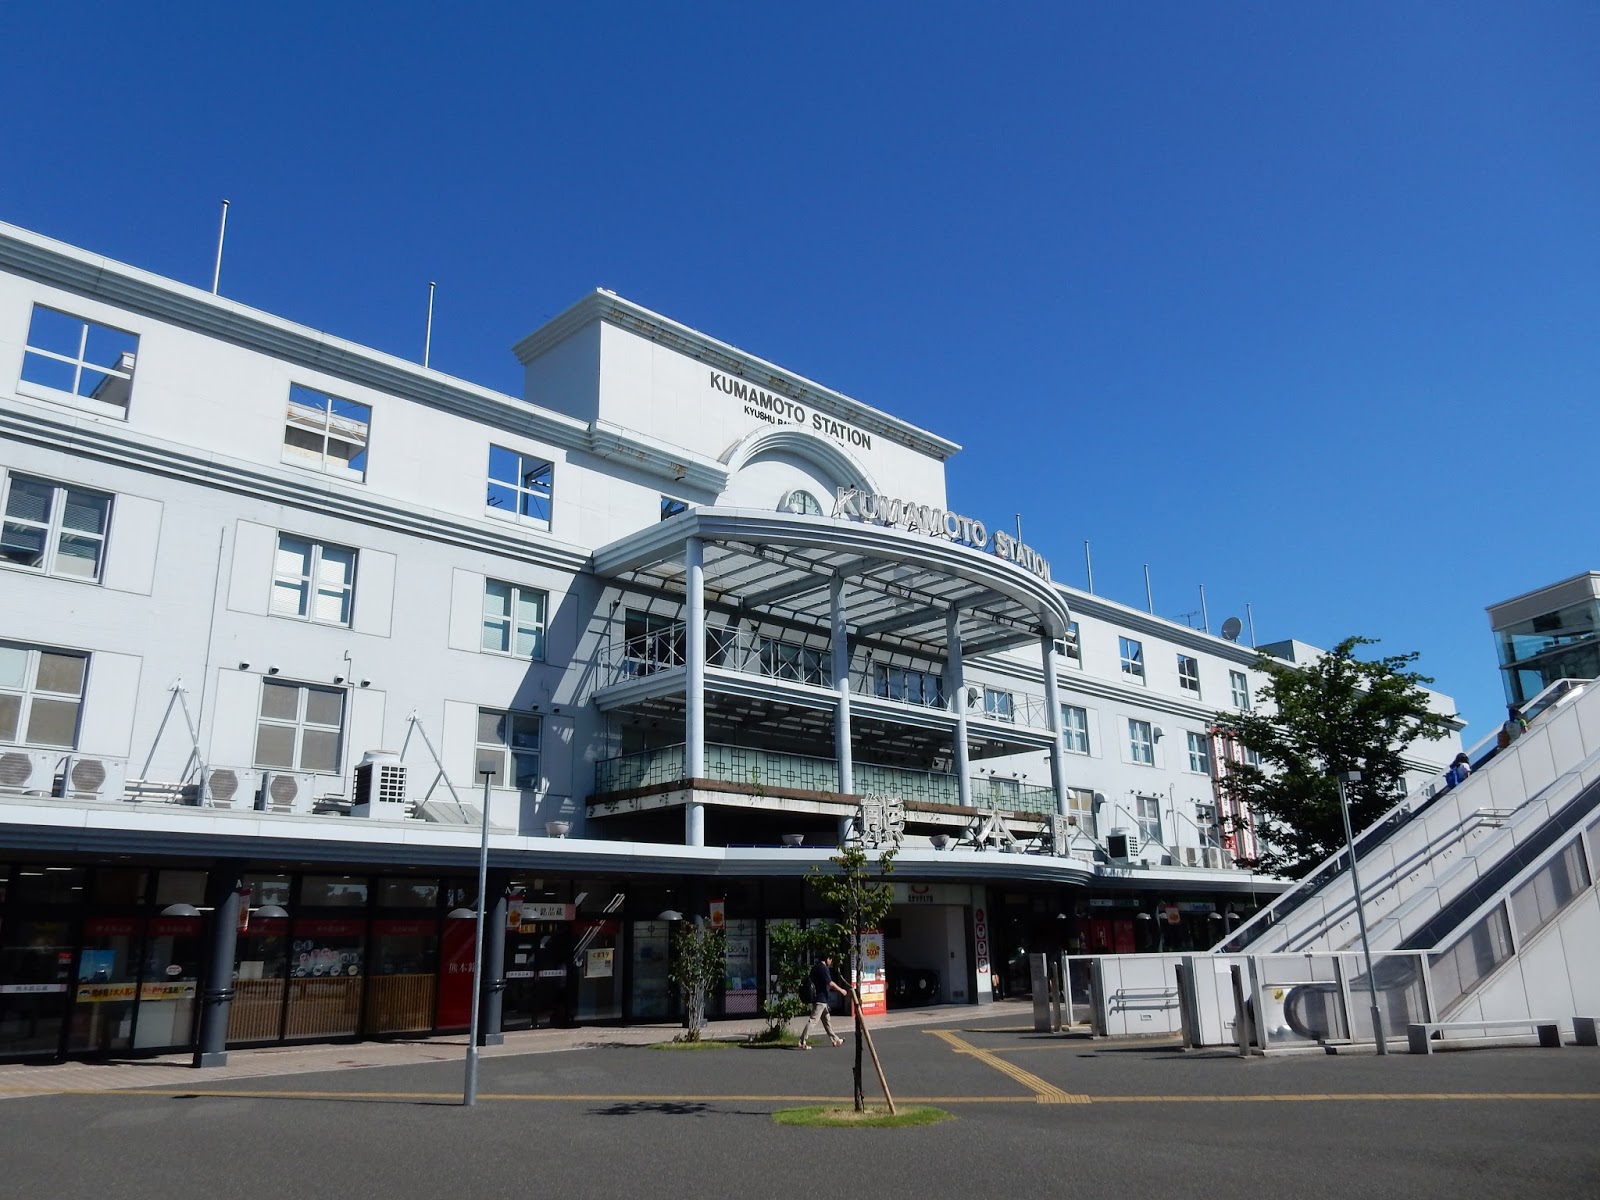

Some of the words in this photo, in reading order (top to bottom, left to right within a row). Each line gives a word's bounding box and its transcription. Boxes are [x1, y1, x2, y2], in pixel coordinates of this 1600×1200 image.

[710, 371, 806, 424] KUMAMOTO
[812, 412, 872, 451] STATION
[744, 405, 775, 425] KYUSHU
[836, 486, 988, 548] KUMAMOTO
[993, 530, 1052, 583] STATION
